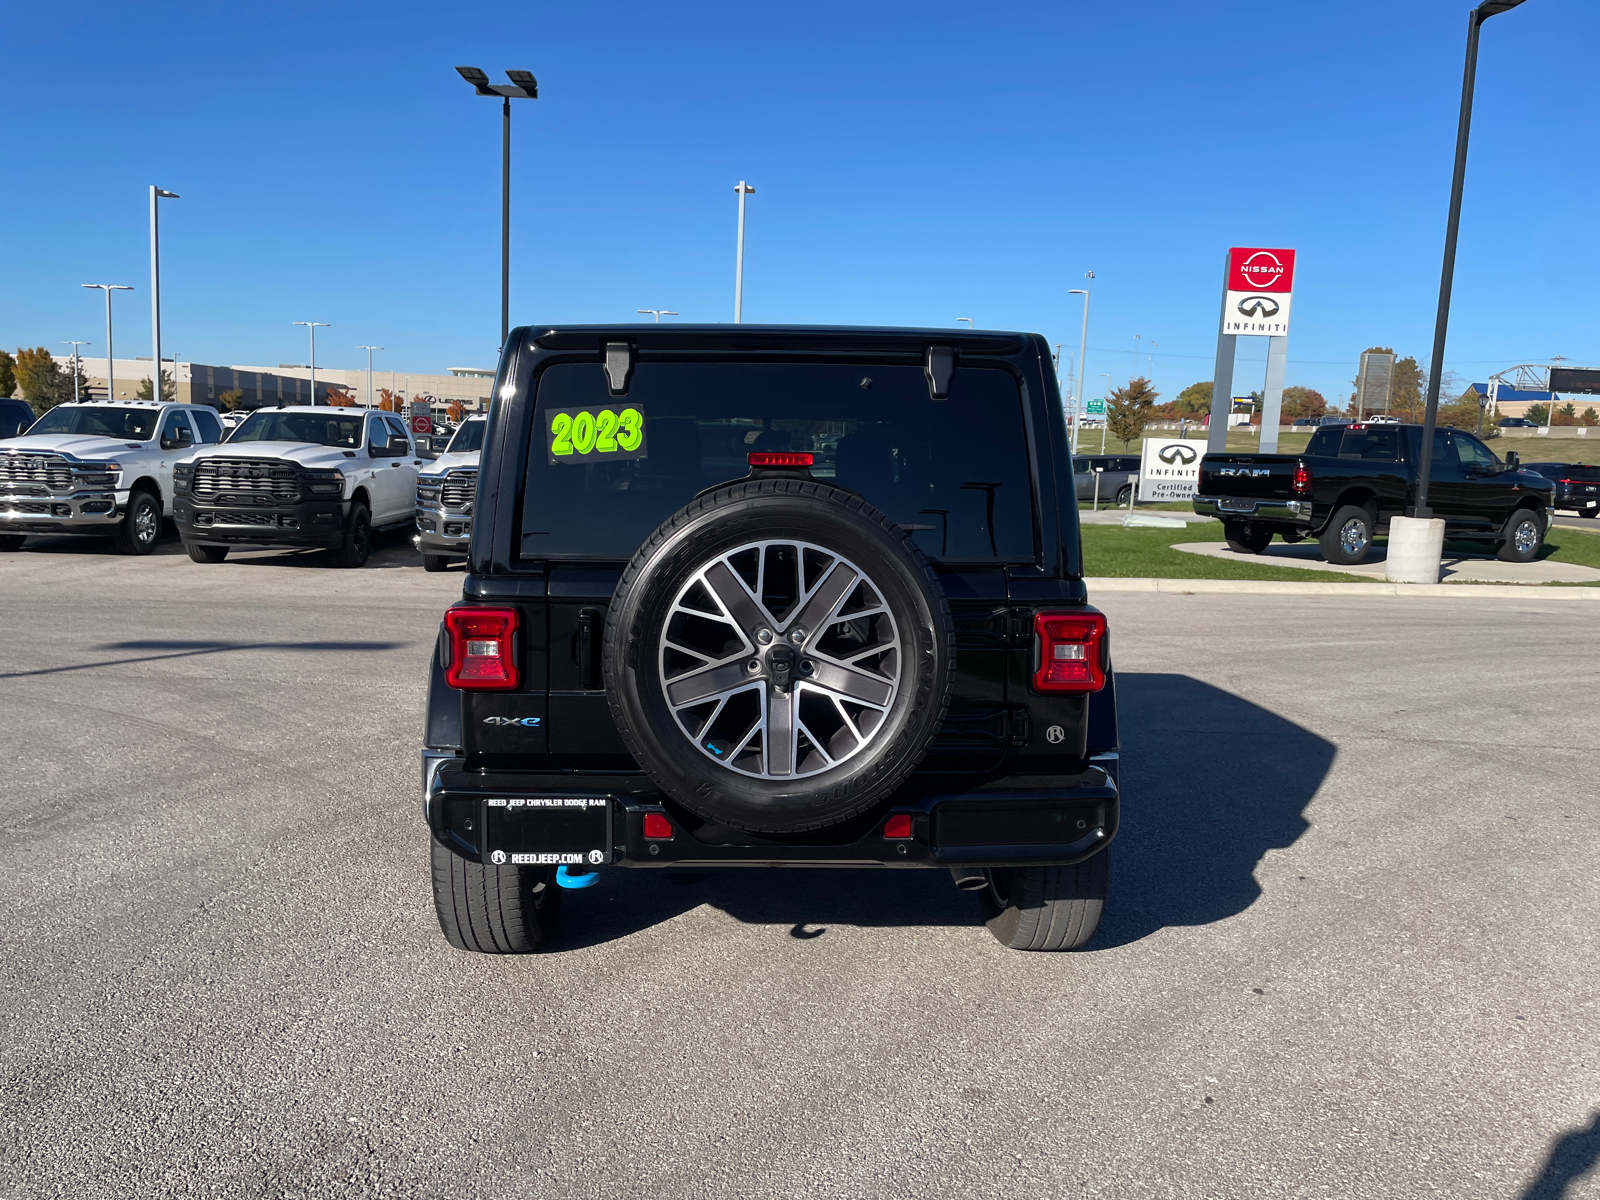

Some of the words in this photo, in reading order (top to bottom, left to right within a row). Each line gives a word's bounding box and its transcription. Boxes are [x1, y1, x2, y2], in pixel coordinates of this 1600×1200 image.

[1240, 265, 1284, 274] NISSAN
[1227, 322, 1286, 332] INFINITI
[551, 408, 644, 456] 2023
[218, 467, 269, 477] RAM
[1150, 468, 1197, 477] INFINIT
[1220, 468, 1270, 478] RAM
[1156, 483, 1193, 491] Certified
[488, 799, 506, 807] REED
[508, 799, 525, 807] JEEP
[511, 854, 583, 864] REEDJEEP.COM
